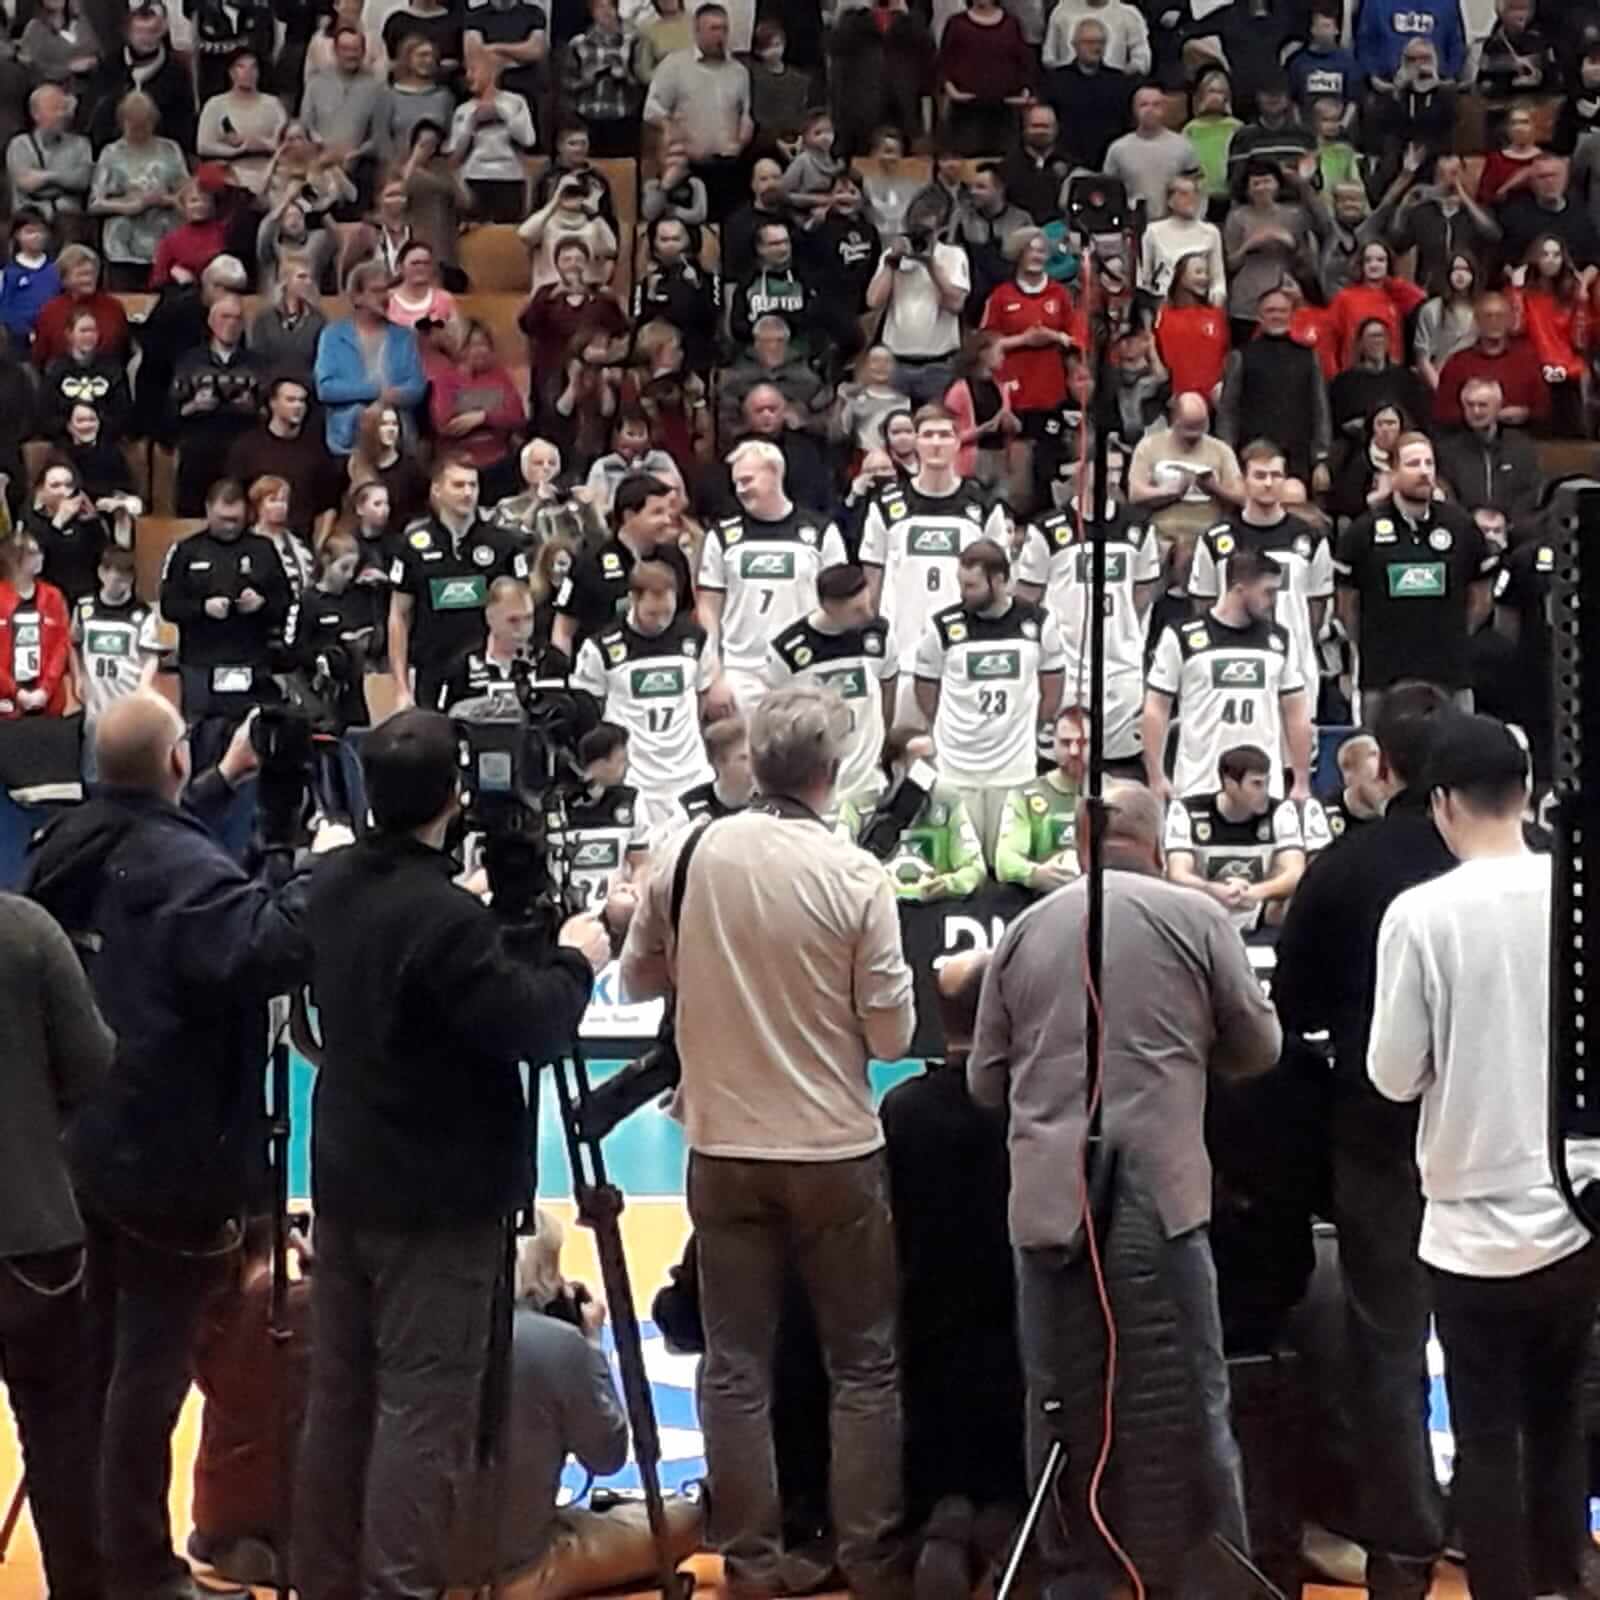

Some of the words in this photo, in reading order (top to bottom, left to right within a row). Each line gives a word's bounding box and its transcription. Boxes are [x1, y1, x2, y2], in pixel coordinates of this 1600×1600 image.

[760, 588, 774, 615] 7
[978, 688, 1007, 716] 23
[1221, 698, 1254, 725] 40
[647, 706, 675, 733] 17
